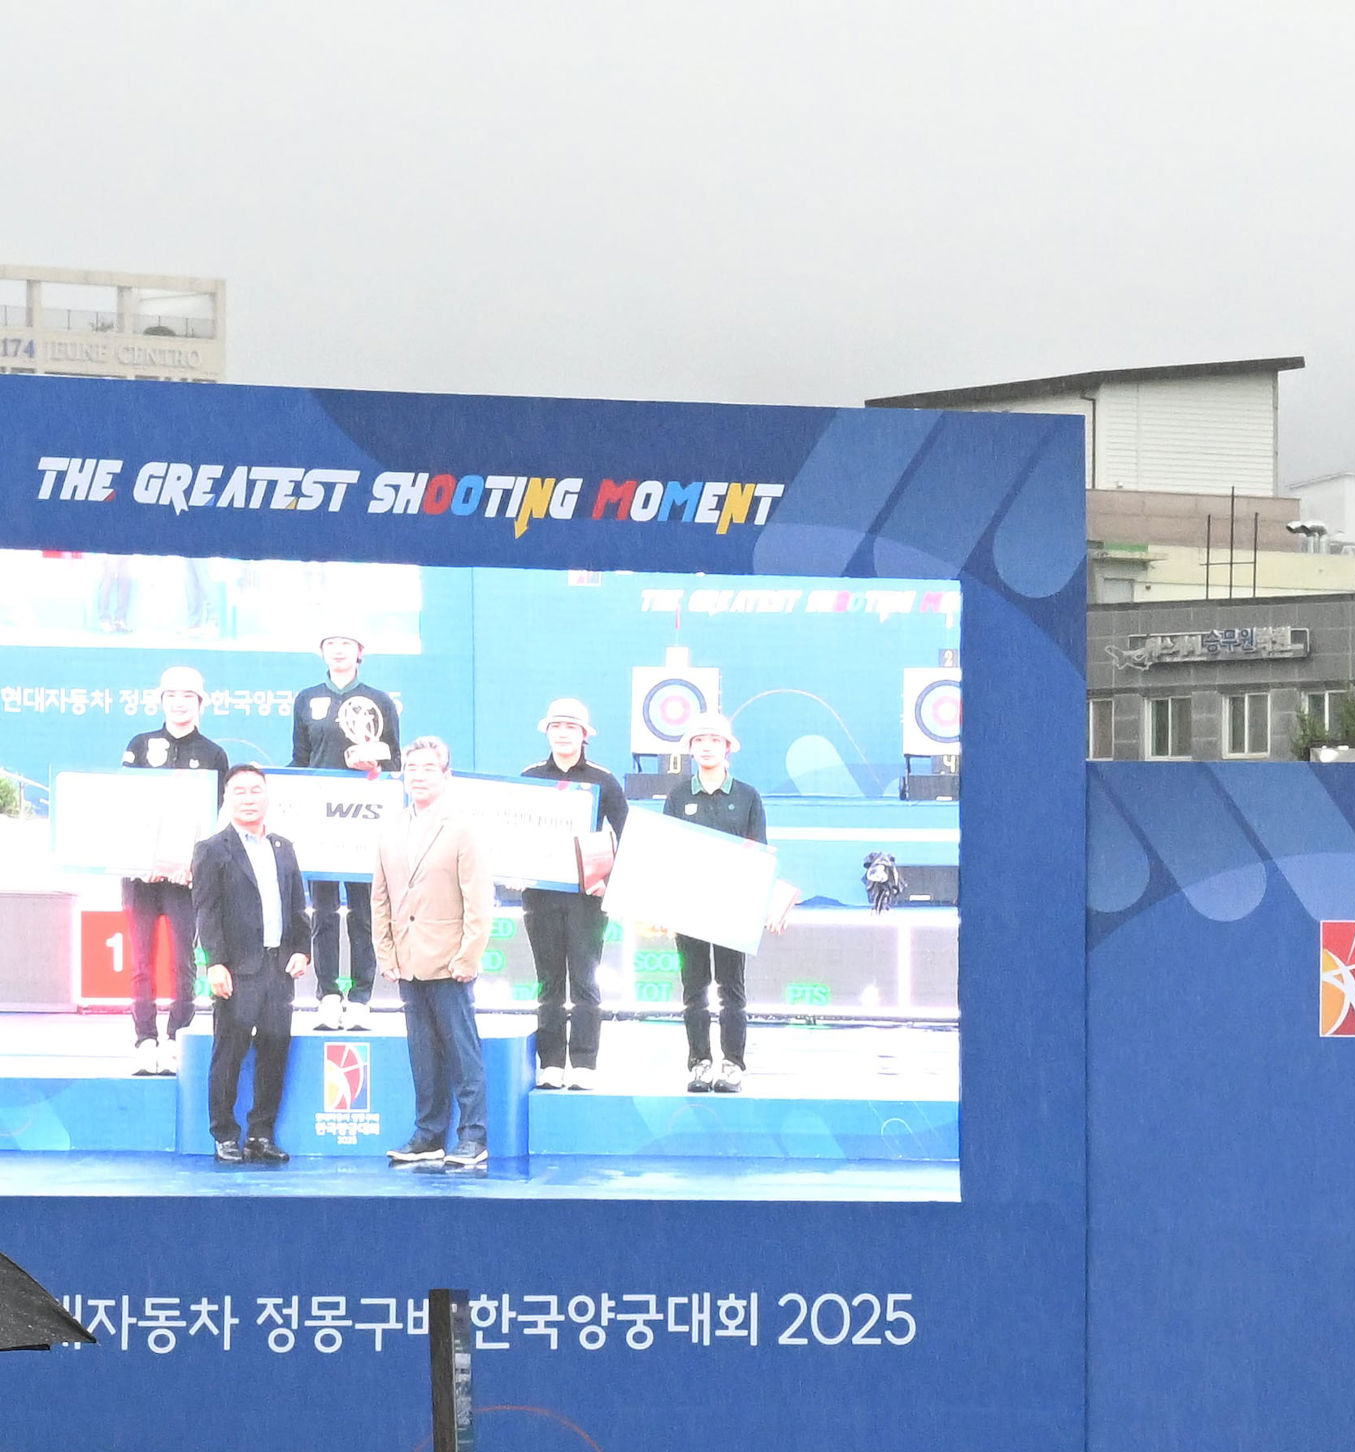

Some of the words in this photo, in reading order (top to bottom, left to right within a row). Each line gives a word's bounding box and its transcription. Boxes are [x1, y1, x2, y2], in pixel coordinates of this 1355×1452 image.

[38, 457, 121, 501] THE
[133, 462, 360, 515] GREATEST
[368, 472, 580, 538] SHOOTING
[592, 479, 784, 534] MOMENT
[470, 1292, 757, 1351] 한국양궁대회
[778, 1293, 916, 1345] 2025
